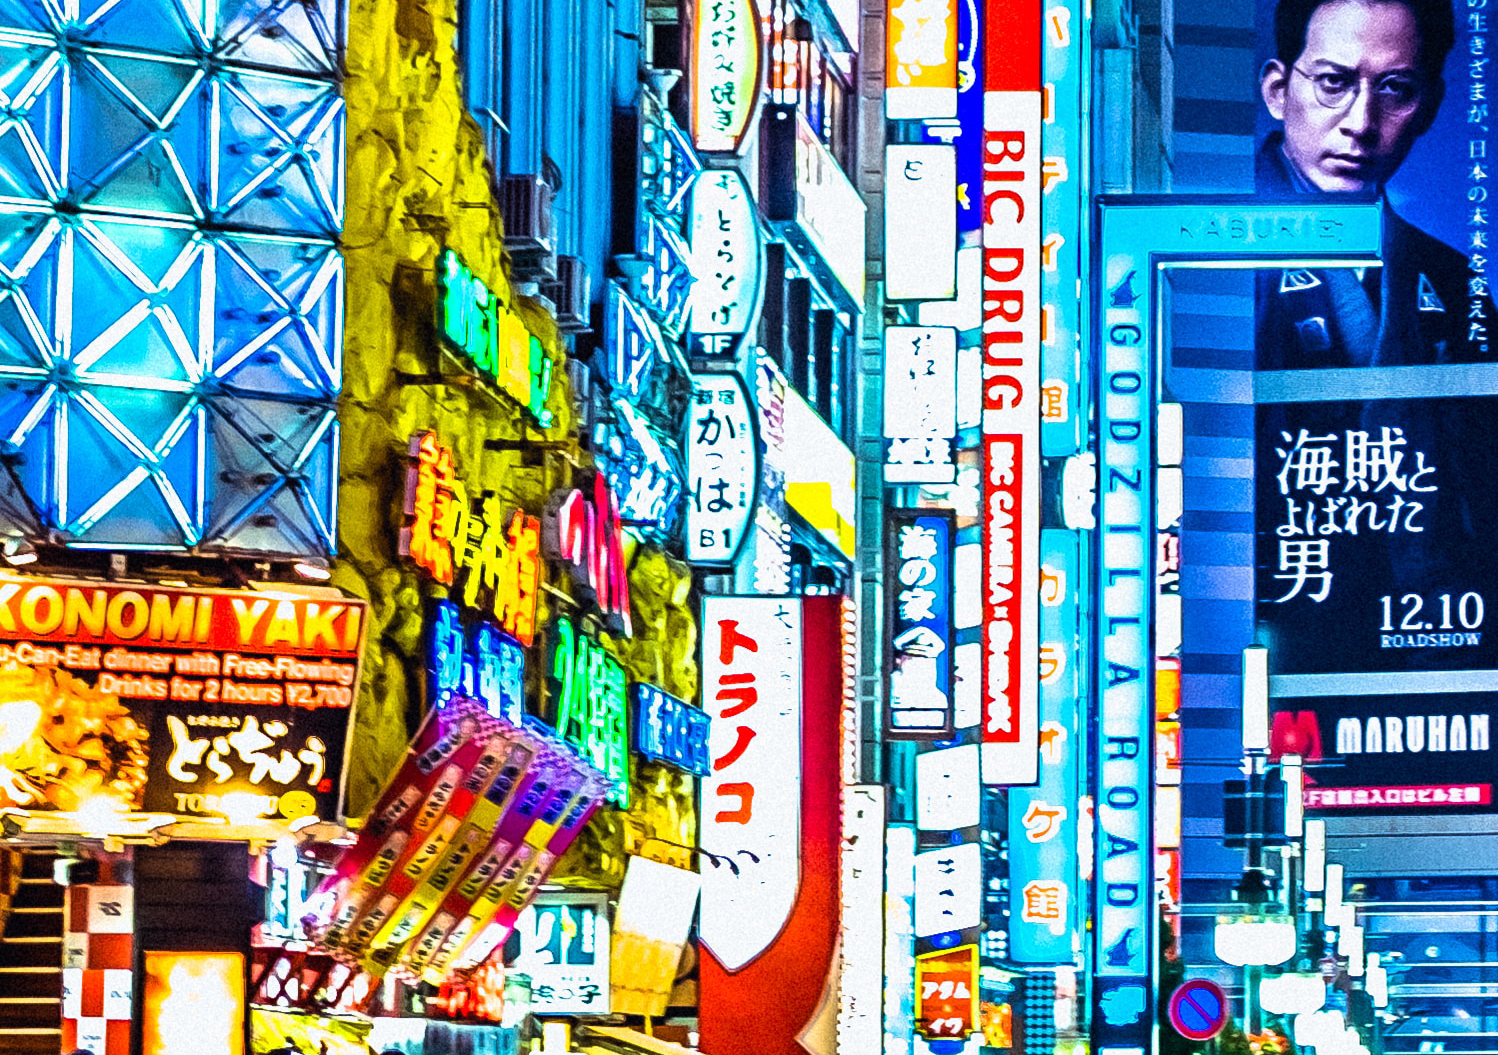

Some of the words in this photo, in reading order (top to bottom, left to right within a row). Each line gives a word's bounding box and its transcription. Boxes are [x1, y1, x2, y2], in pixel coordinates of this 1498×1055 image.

[984, 130, 1025, 225] BIC
[699, 335, 732, 354] 1F
[984, 246, 1025, 410] DRUG
[989, 442, 1013, 486] BIC
[1275, 426, 1438, 495] 海賊と
[1109, 325, 1142, 687] GODZILLA
[1276, 496, 1424, 535] よばれた
[700, 529, 731, 548] B1
[1274, 539, 1334, 603] 男
[232, 598, 362, 652] YAKI
[1379, 592, 1485, 632] 12.10
[1381, 633, 1481, 648] ROADSHOW
[100, 672, 167, 696] Drinks
[171, 678, 202, 699] for
[205, 680, 220, 700] 2
[223, 679, 282, 703] hours
[104, 649, 172, 673] dinner
[175, 653, 220, 674] with
[223, 655, 354, 683] Free-Flowing
[715, 620, 757, 825] トラノコ
[1336, 715, 1489, 754] MARUHAN
[1108, 737, 1140, 909] ROAD
